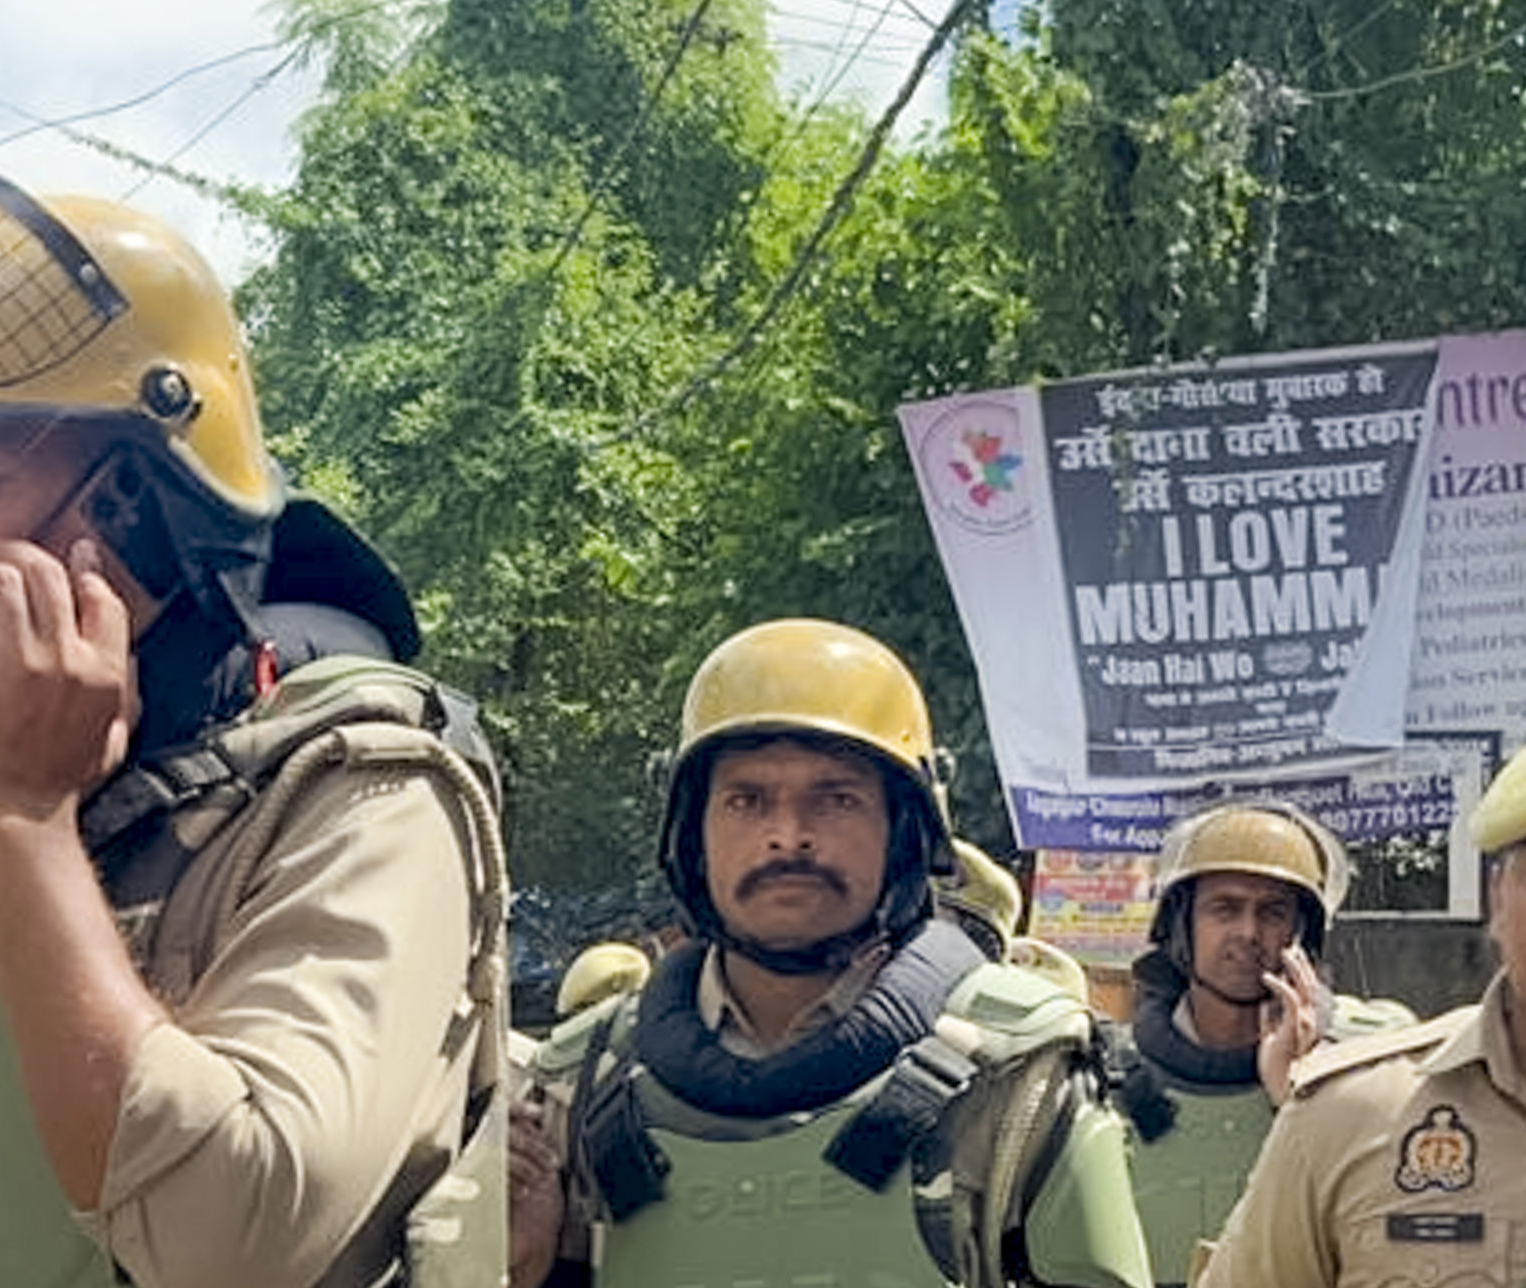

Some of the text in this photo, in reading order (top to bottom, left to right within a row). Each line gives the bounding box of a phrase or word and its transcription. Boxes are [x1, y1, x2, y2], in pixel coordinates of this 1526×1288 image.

[1162, 504, 1349, 578] I LOVE
[1075, 561, 1390, 645] MUHAMM
[1163, 652, 1206, 684] Hai
[1208, 651, 1255, 681] Wo
